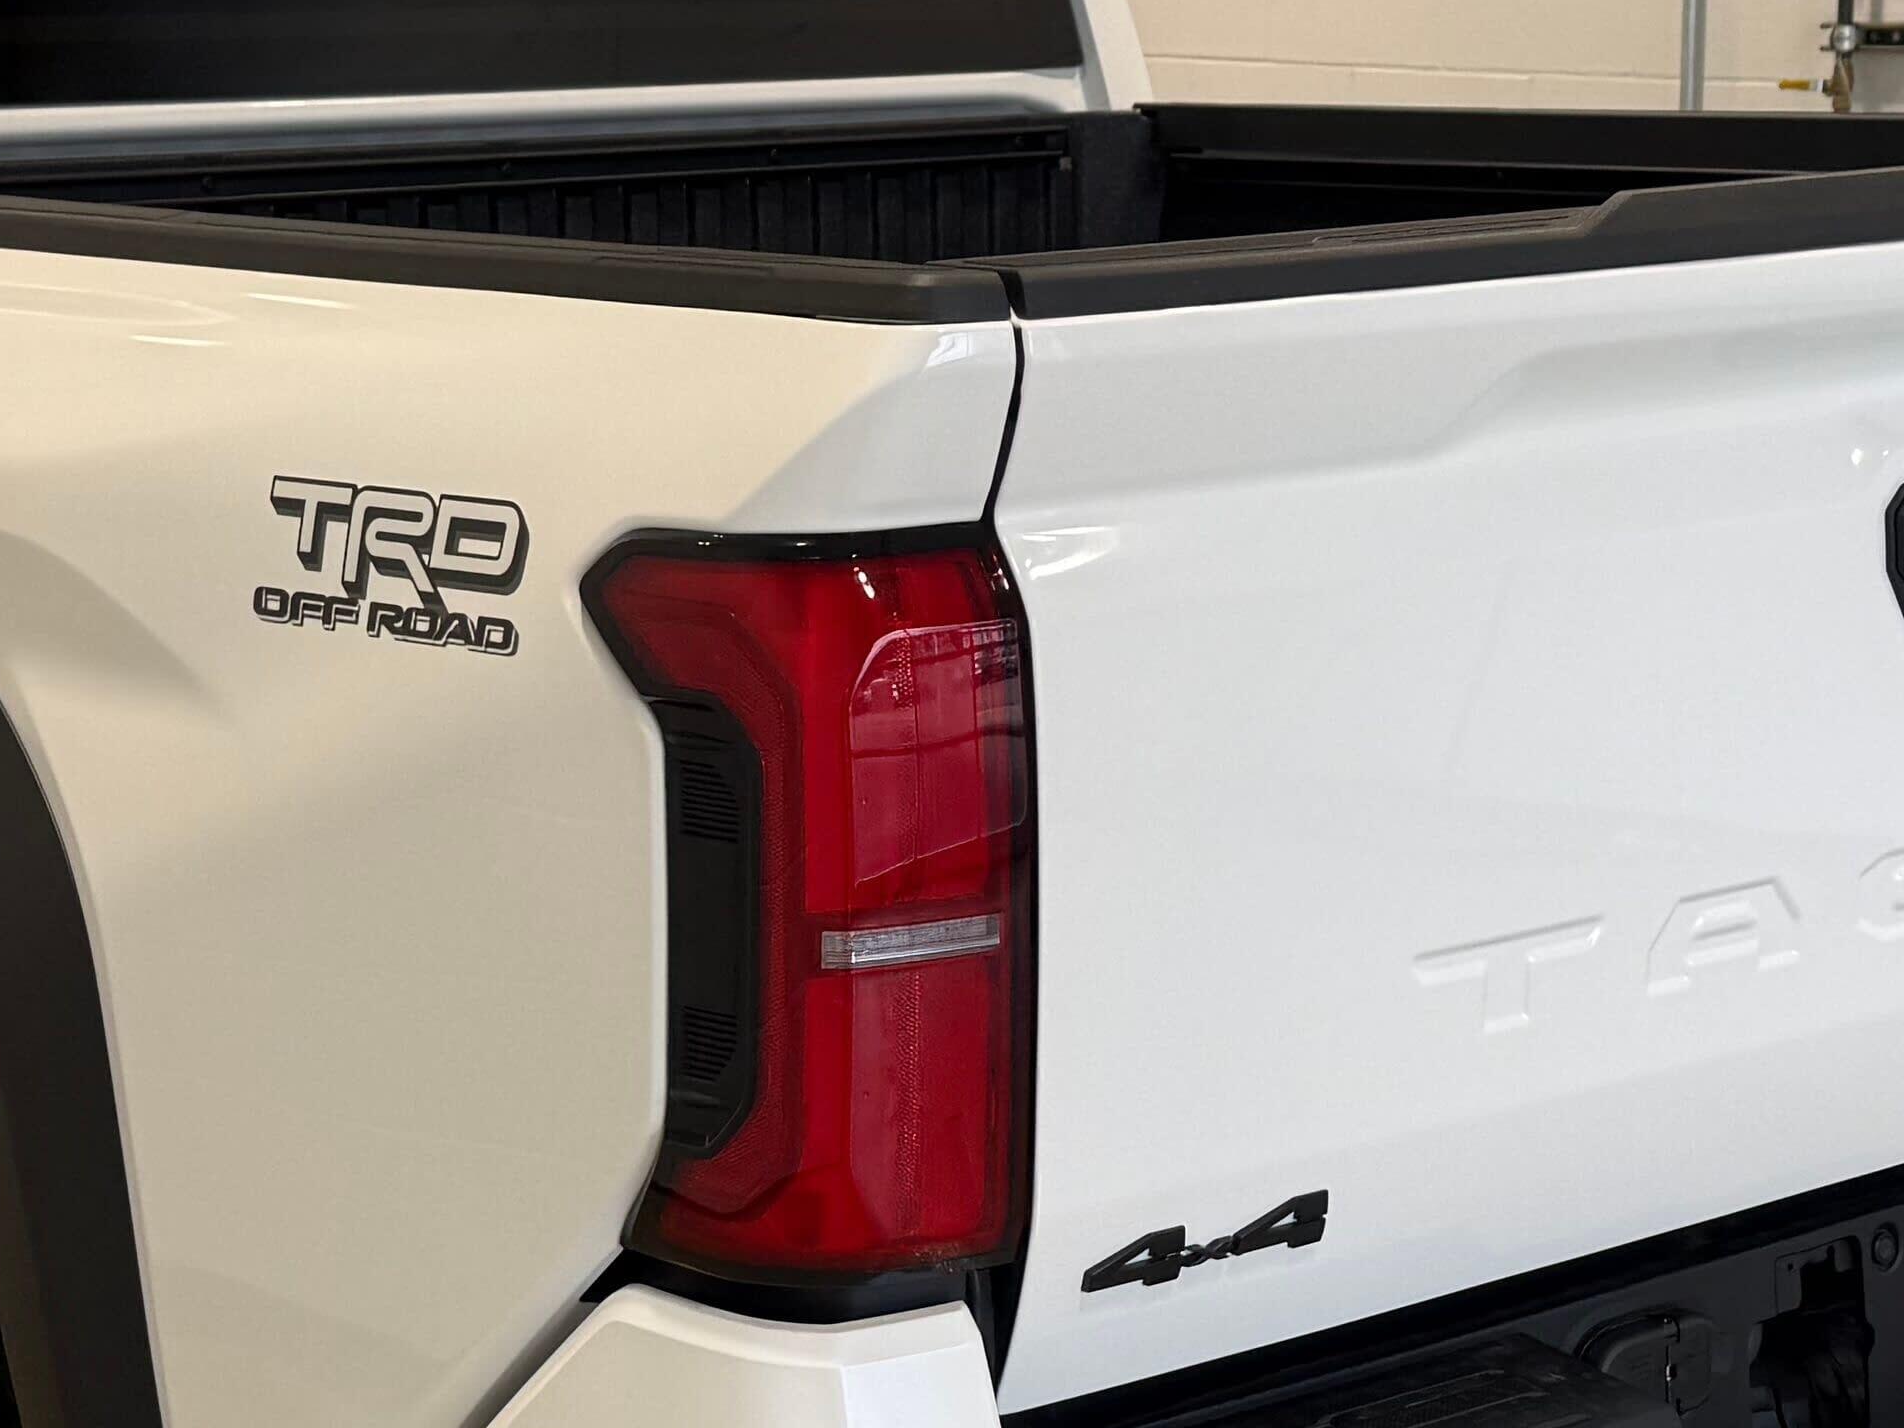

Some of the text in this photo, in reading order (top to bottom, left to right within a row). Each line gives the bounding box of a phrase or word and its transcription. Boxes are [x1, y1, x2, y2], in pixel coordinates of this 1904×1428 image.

[270, 475, 530, 613] TRD
[253, 586, 520, 656] OFF ROAD
